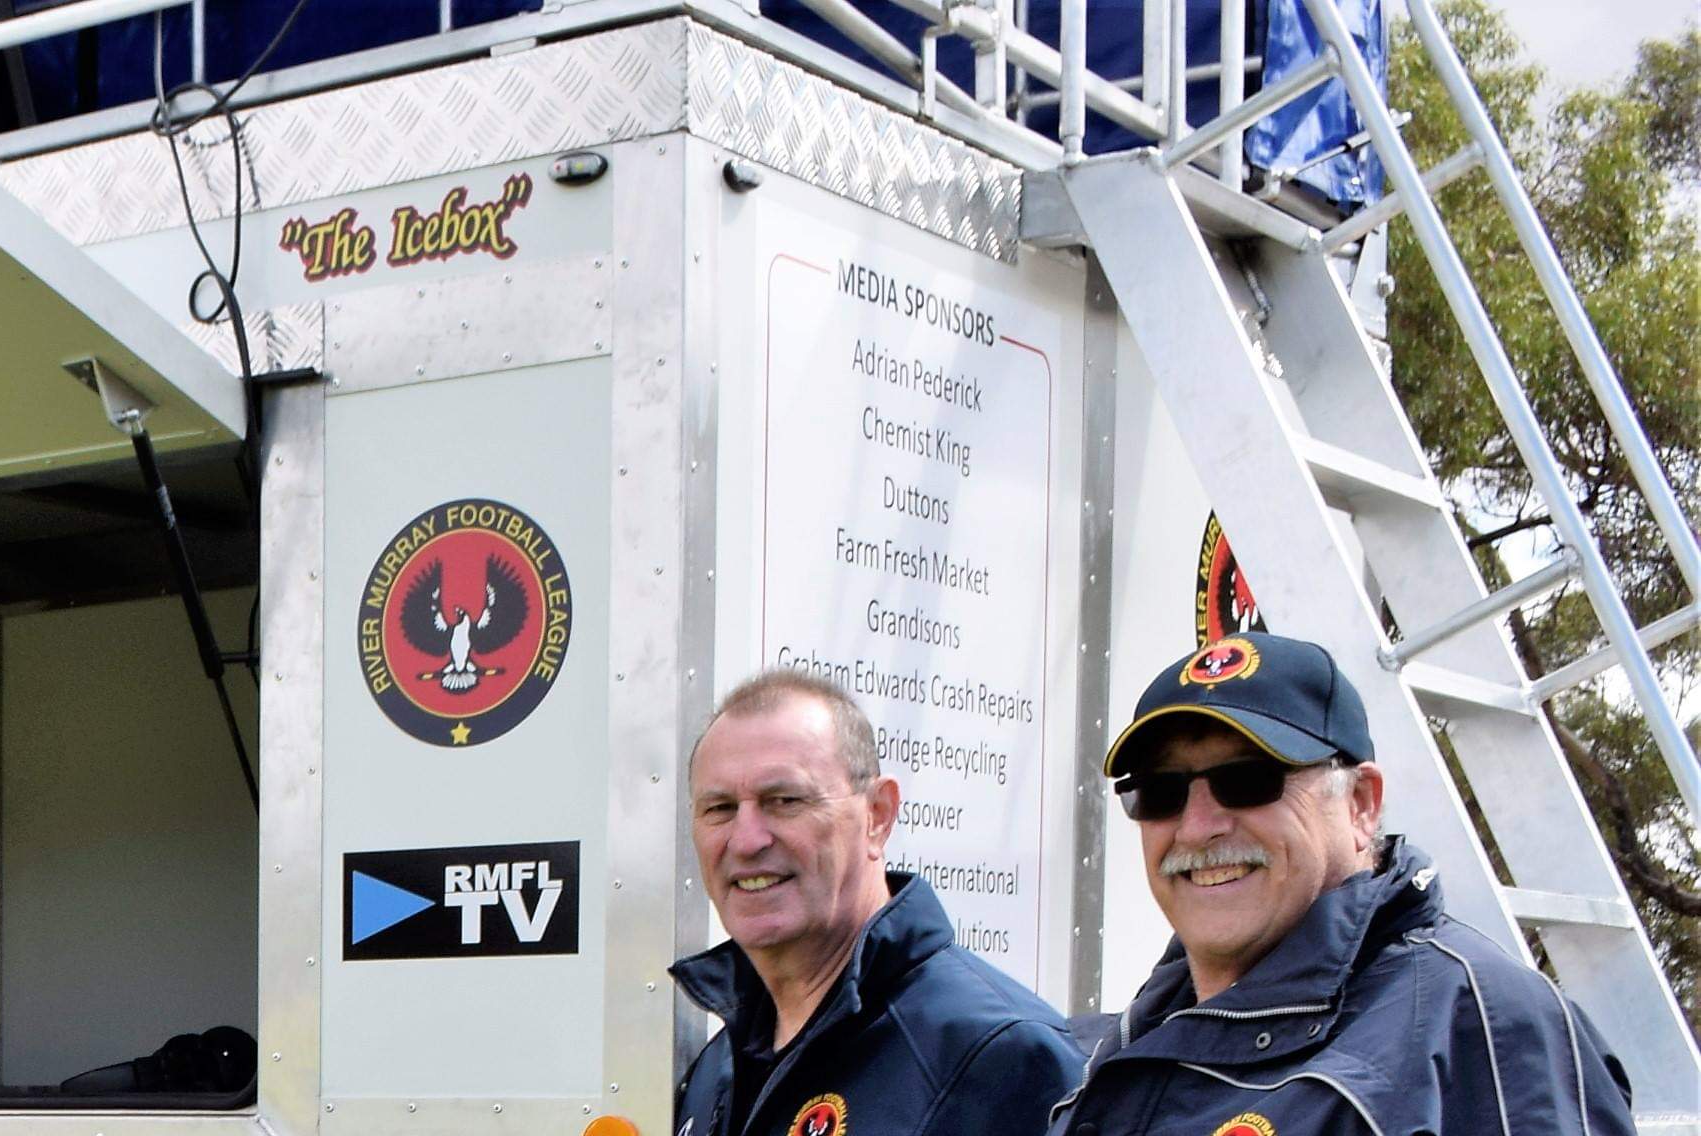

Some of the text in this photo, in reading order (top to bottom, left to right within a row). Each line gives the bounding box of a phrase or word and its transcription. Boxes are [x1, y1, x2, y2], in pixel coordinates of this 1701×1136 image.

[280, 173, 532, 281] "The Icebox"
[838, 258, 995, 346] MEDIA SPONSORS
[852, 339, 982, 412] Adrian Pederick
[862, 406, 971, 477] Chemist King
[883, 476, 949, 525] Duttons
[836, 527, 990, 596] Farm Fresh Market
[362, 504, 567, 694] RIVER MURRAY FOOTBALL LEAGUE
[866, 599, 960, 650] Grandisons
[855, 660, 926, 704] Edwards
[930, 674, 974, 713] Crash
[978, 683, 1034, 726] Repairs
[877, 727, 1007, 785] Bridge Recycling
[444, 861, 564, 892] RMFL
[918, 857, 1019, 896] International
[444, 886, 563, 944] TV
[957, 918, 1009, 953] lutions
